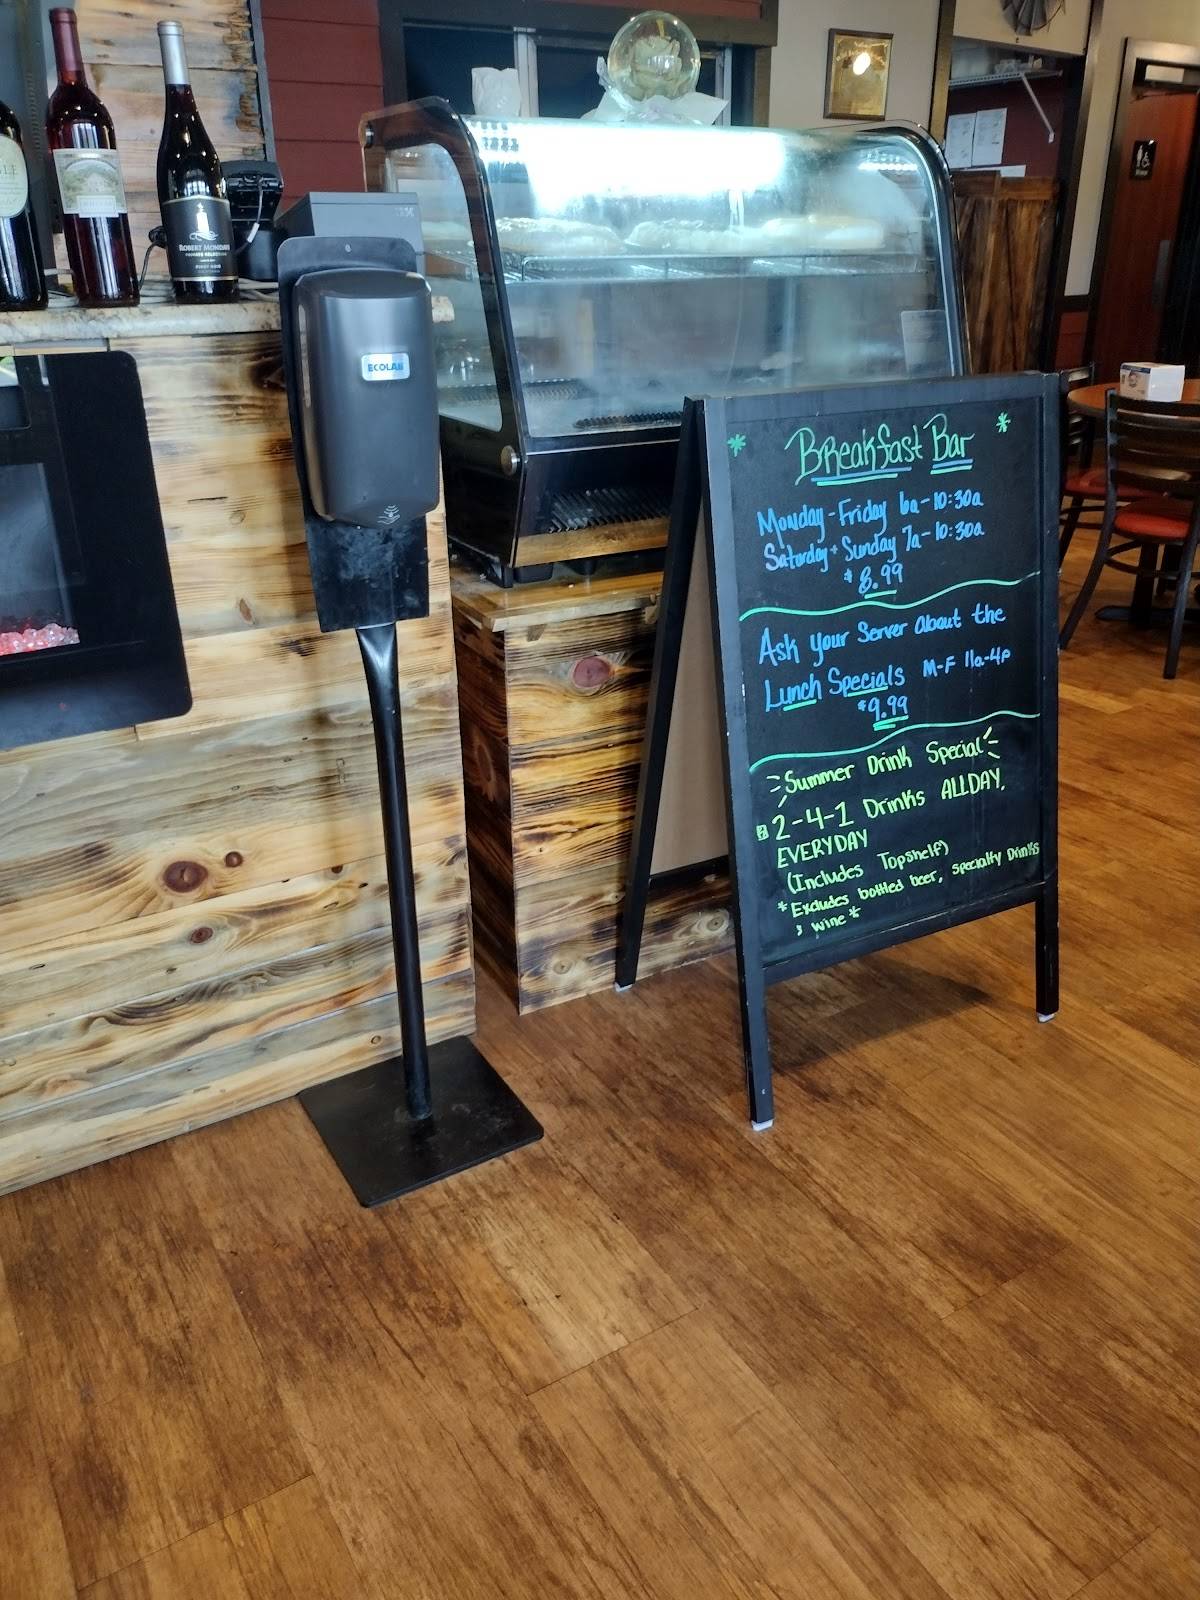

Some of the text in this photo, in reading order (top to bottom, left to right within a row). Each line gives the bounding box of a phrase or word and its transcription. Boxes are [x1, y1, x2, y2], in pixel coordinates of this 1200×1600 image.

[923, 413, 975, 462] Bar
[763, 542, 829, 573] Saturday
[841, 535, 897, 563] Sunday
[758, 627, 800, 666] Ask
[809, 631, 850, 667] your
[857, 621, 908, 643] Server
[971, 602, 1006, 624] the
[764, 673, 823, 712] Lunch
[827, 664, 906, 698] Specials
[784, 736, 984, 794] Summer Drink Special
[862, 789, 926, 819] Drinks
[777, 829, 869, 869] EVERYDAY
[857, 878, 905, 900] bottled
[951, 850, 1002, 875] specialty
[1006, 841, 1040, 862] Drinks
